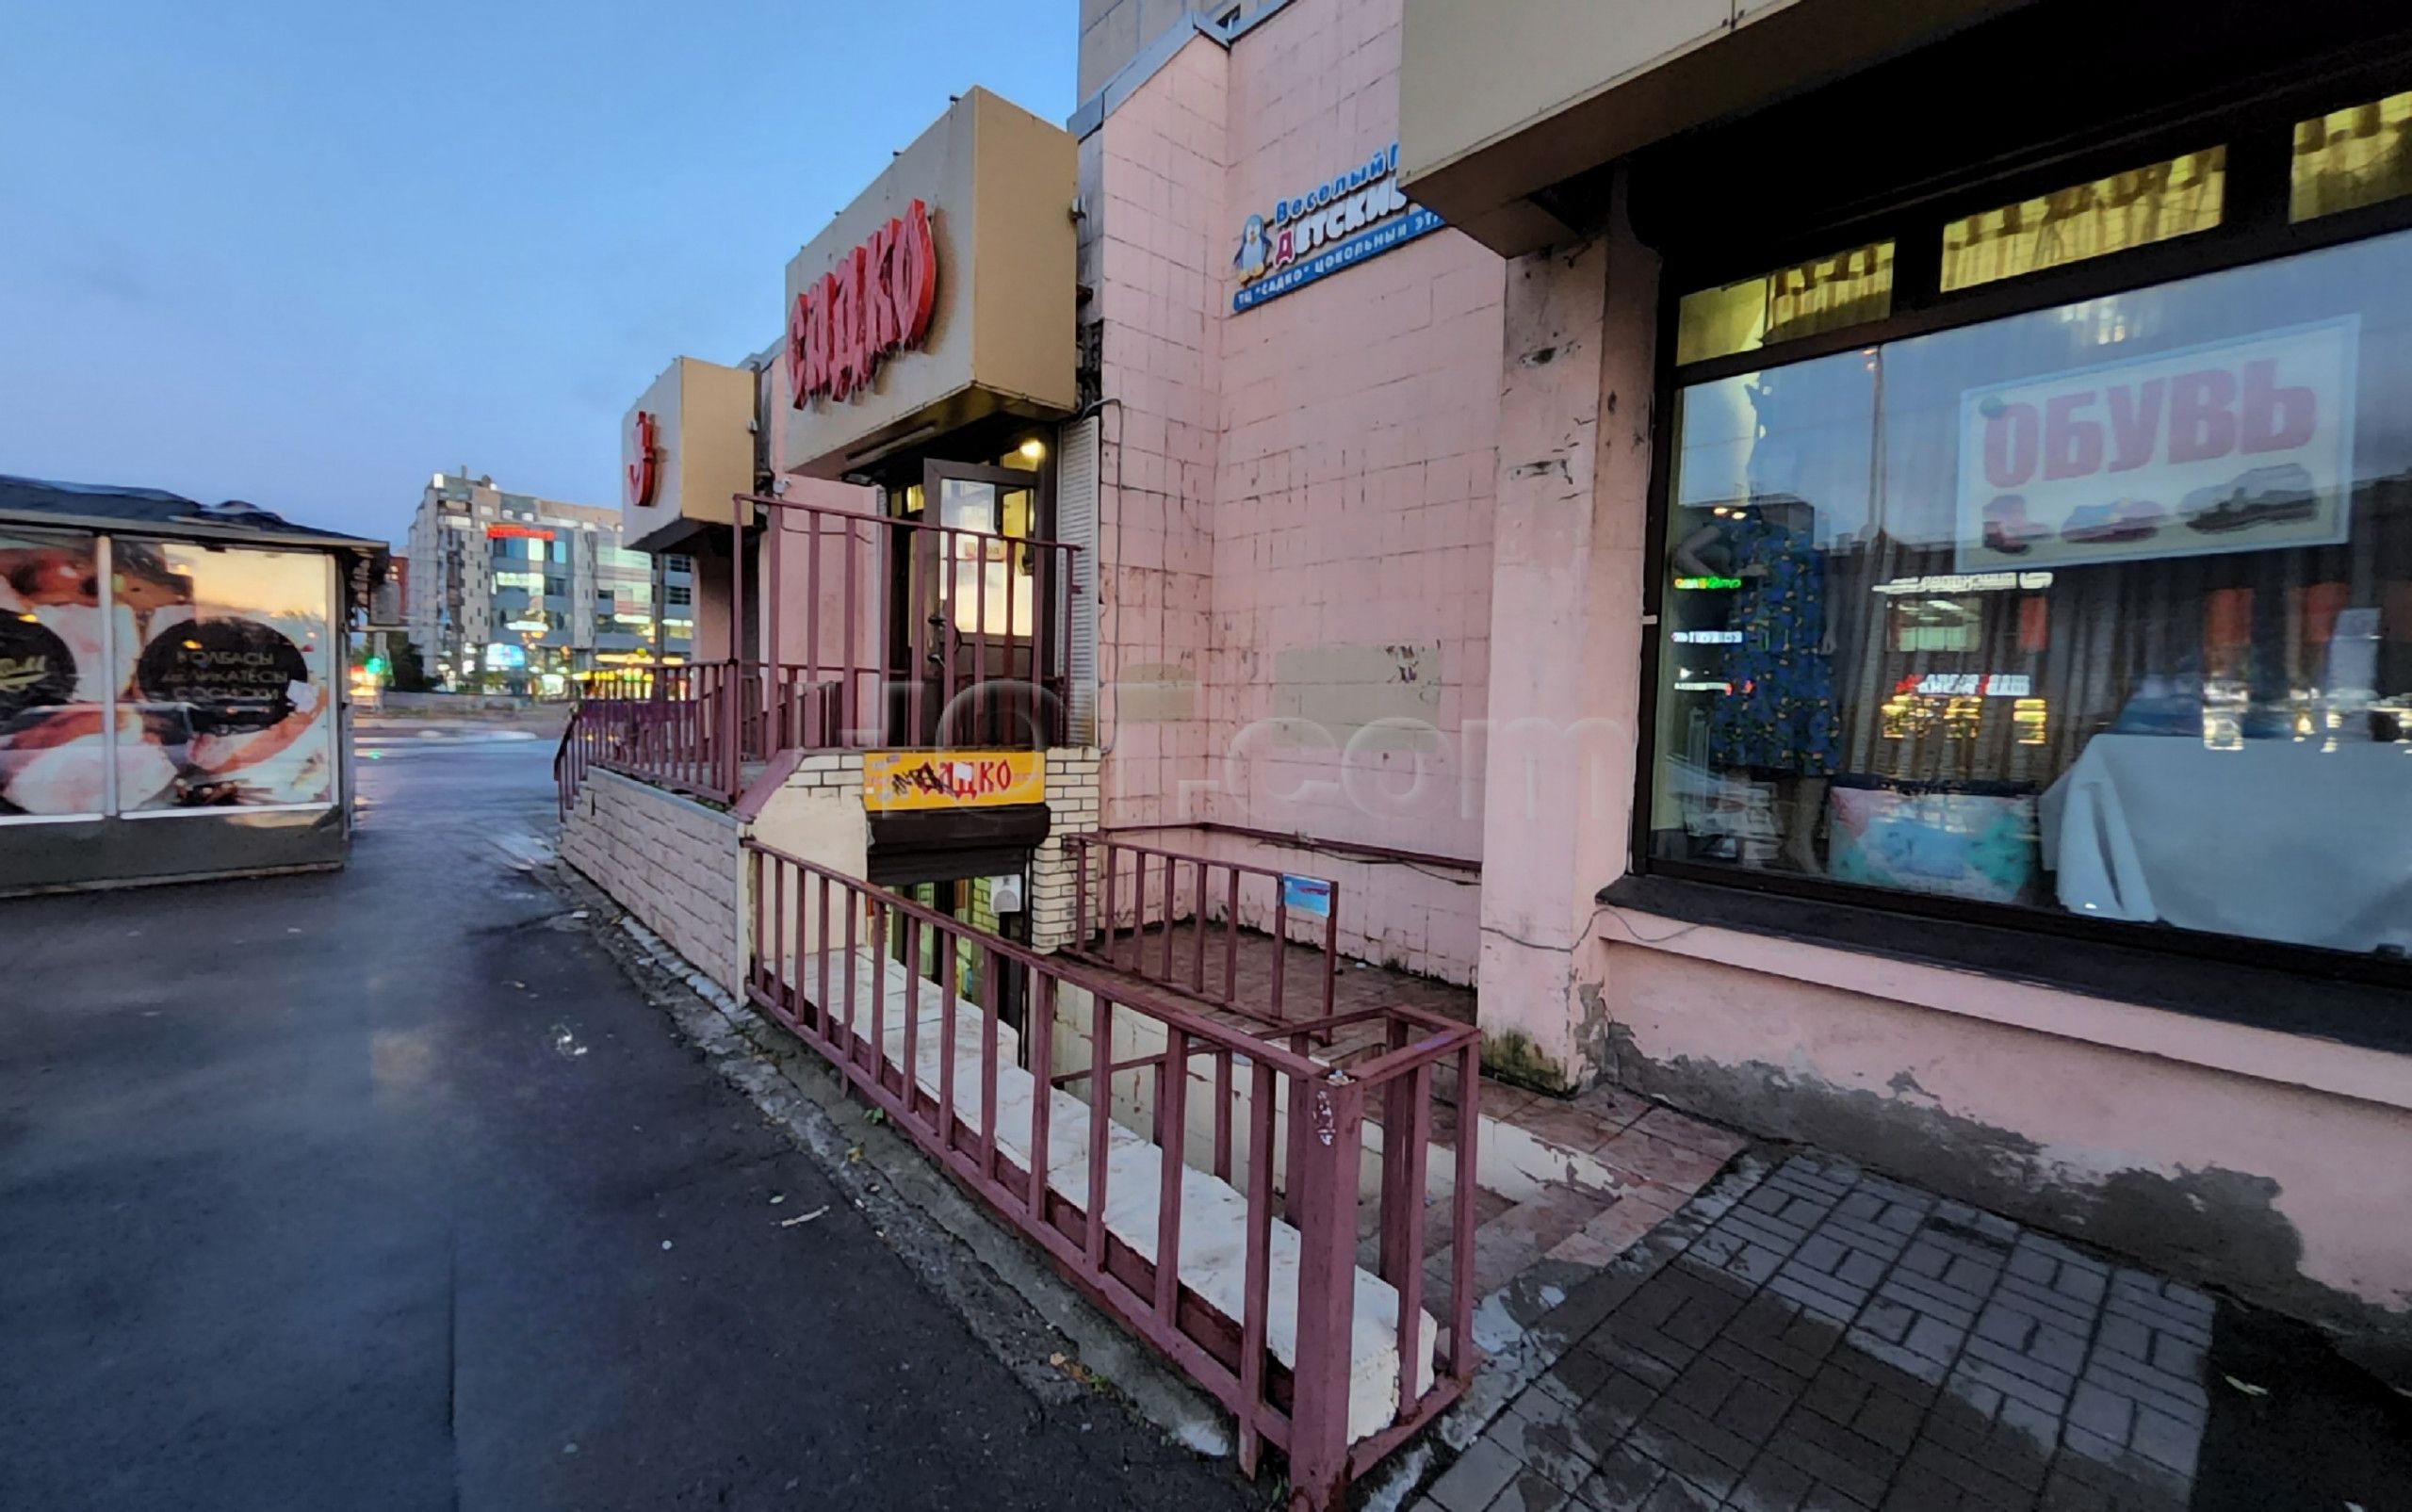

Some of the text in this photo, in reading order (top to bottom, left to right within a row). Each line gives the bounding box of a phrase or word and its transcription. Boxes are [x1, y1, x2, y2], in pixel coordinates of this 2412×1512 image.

[785, 198, 937, 411] САДКО
[1983, 358, 2317, 488] ОБУВЬ
[177, 650, 275, 666] КОЛБАСЫ
